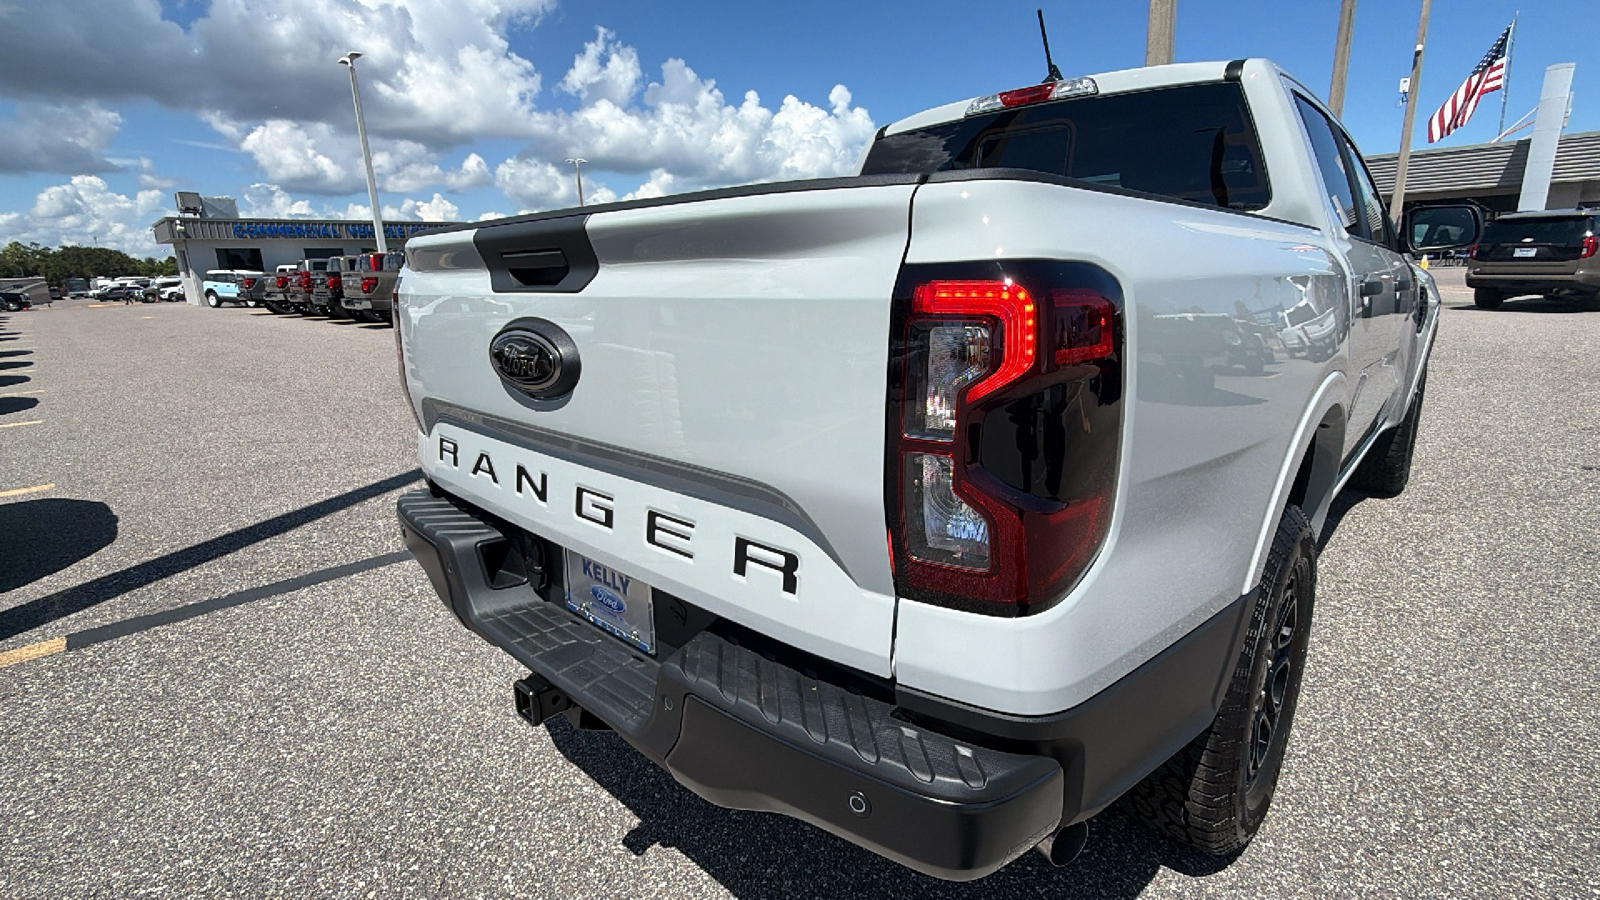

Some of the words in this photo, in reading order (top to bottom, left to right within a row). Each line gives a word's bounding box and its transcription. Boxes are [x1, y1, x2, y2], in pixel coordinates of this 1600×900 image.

[233, 224, 339, 237] COMMERCIAL
[348, 225, 405, 238] VEHCLE
[502, 342, 541, 377] Ford
[439, 437, 800, 597] RANGER
[582, 558, 630, 595] KELLY
[596, 588, 619, 611] Ford
